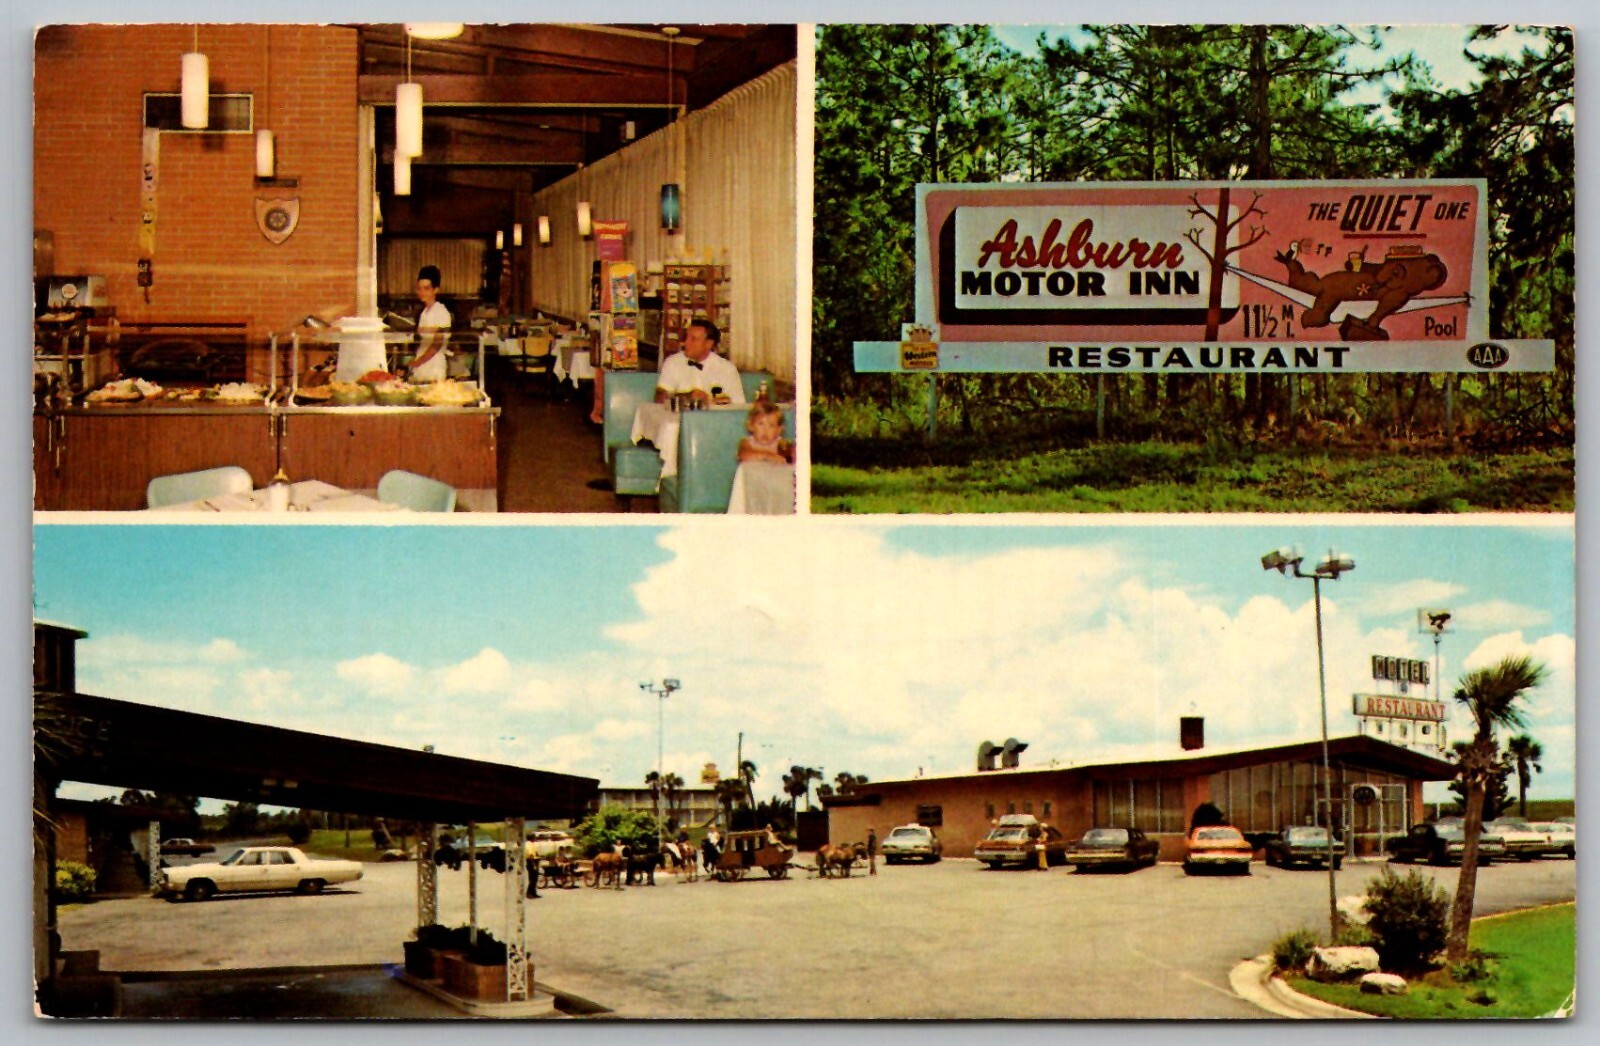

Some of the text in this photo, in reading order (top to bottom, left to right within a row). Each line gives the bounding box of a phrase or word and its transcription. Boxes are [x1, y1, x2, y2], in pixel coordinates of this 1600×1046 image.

[1308, 194, 1471, 232] THE QUIET ONE
[977, 218, 1184, 269] Ashburn
[961, 271, 1199, 296] MOTOR INN
[1425, 316, 1457, 337] Pool
[1049, 347, 1350, 368] RESTAURANT
[1474, 346, 1502, 364] AAA
[1374, 656, 1430, 684] MOTEL
